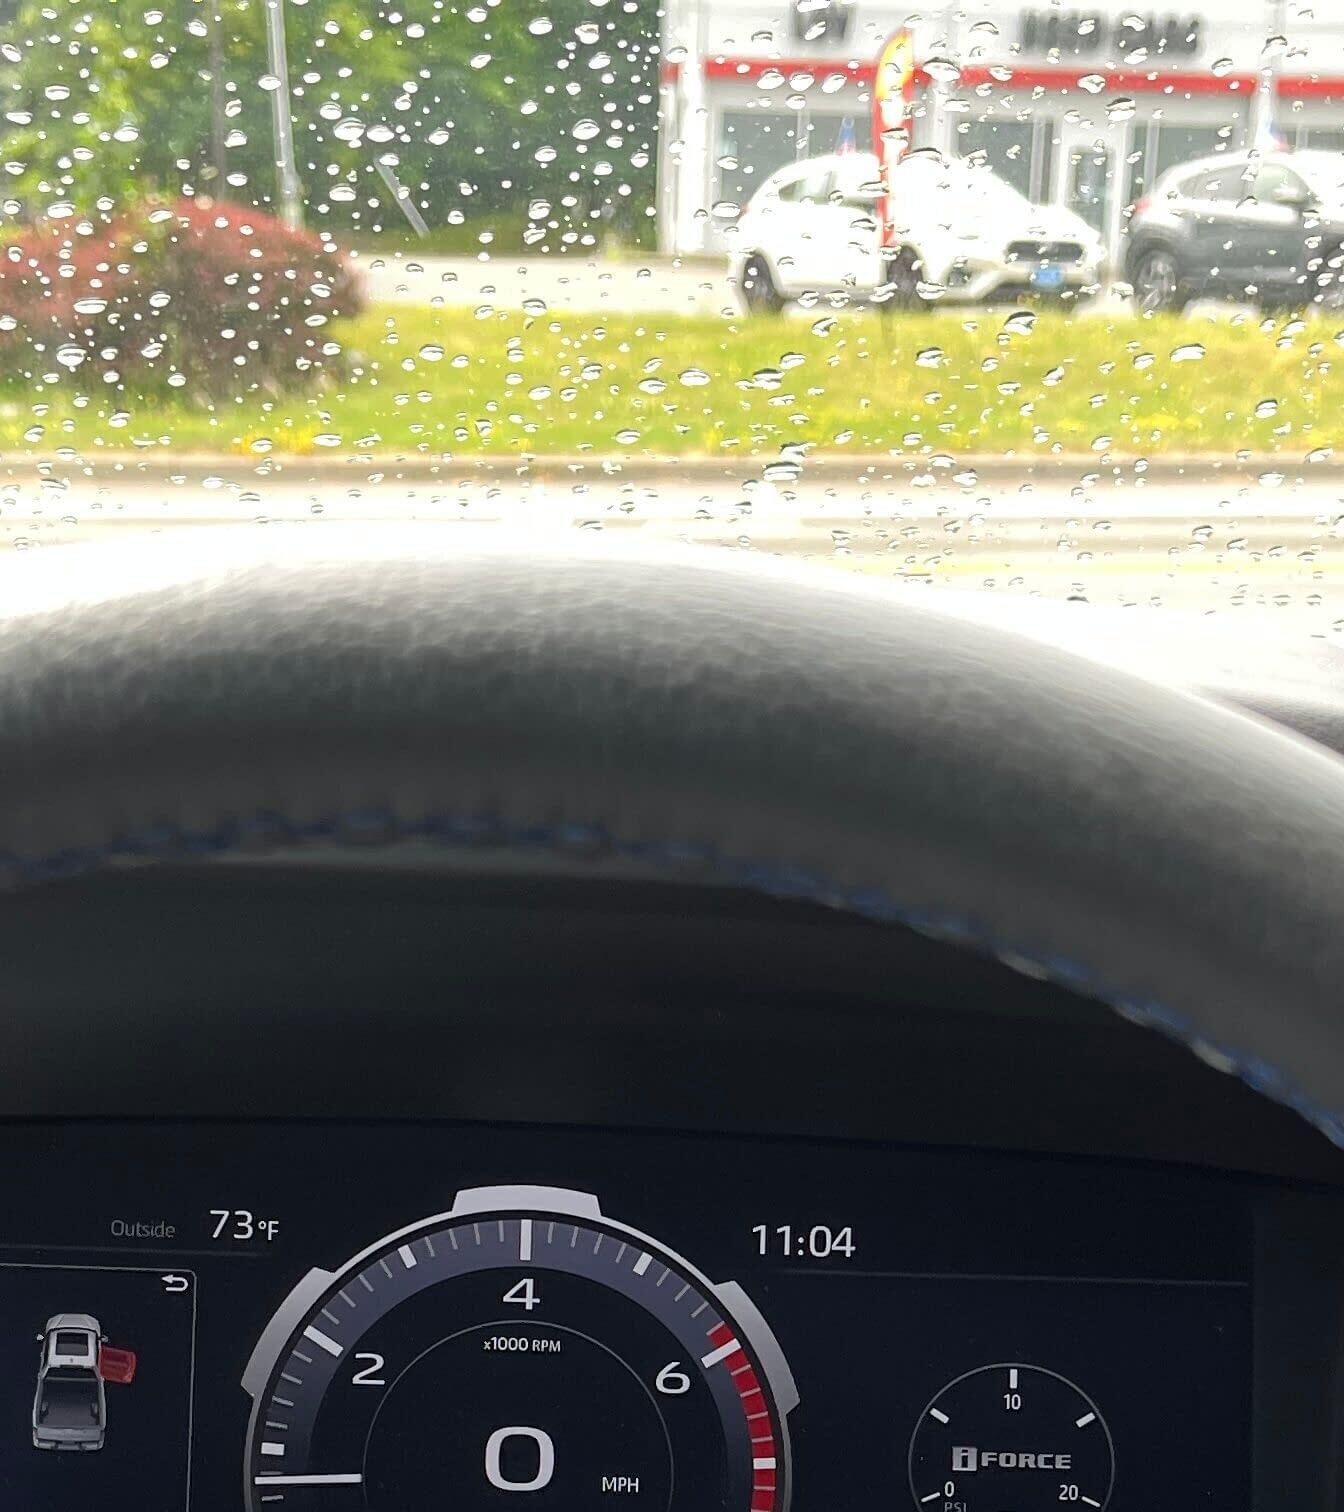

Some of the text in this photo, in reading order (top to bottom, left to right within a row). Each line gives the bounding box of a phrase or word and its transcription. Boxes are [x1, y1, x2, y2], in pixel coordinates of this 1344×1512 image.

[110, 1219, 176, 1240] Outside
[752, 1224, 856, 1258] 11:04
[502, 1277, 540, 1310] 4
[483, 1337, 562, 1353] x1000 RPM
[352, 1352, 386, 1386] 2
[656, 1361, 691, 1394] 6
[1003, 1394, 1021, 1411] 10
[485, 1426, 555, 1491] 0
[602, 1476, 639, 1493] MPH
[944, 1481, 955, 1498] 0
[1058, 1484, 1078, 1501] 20
